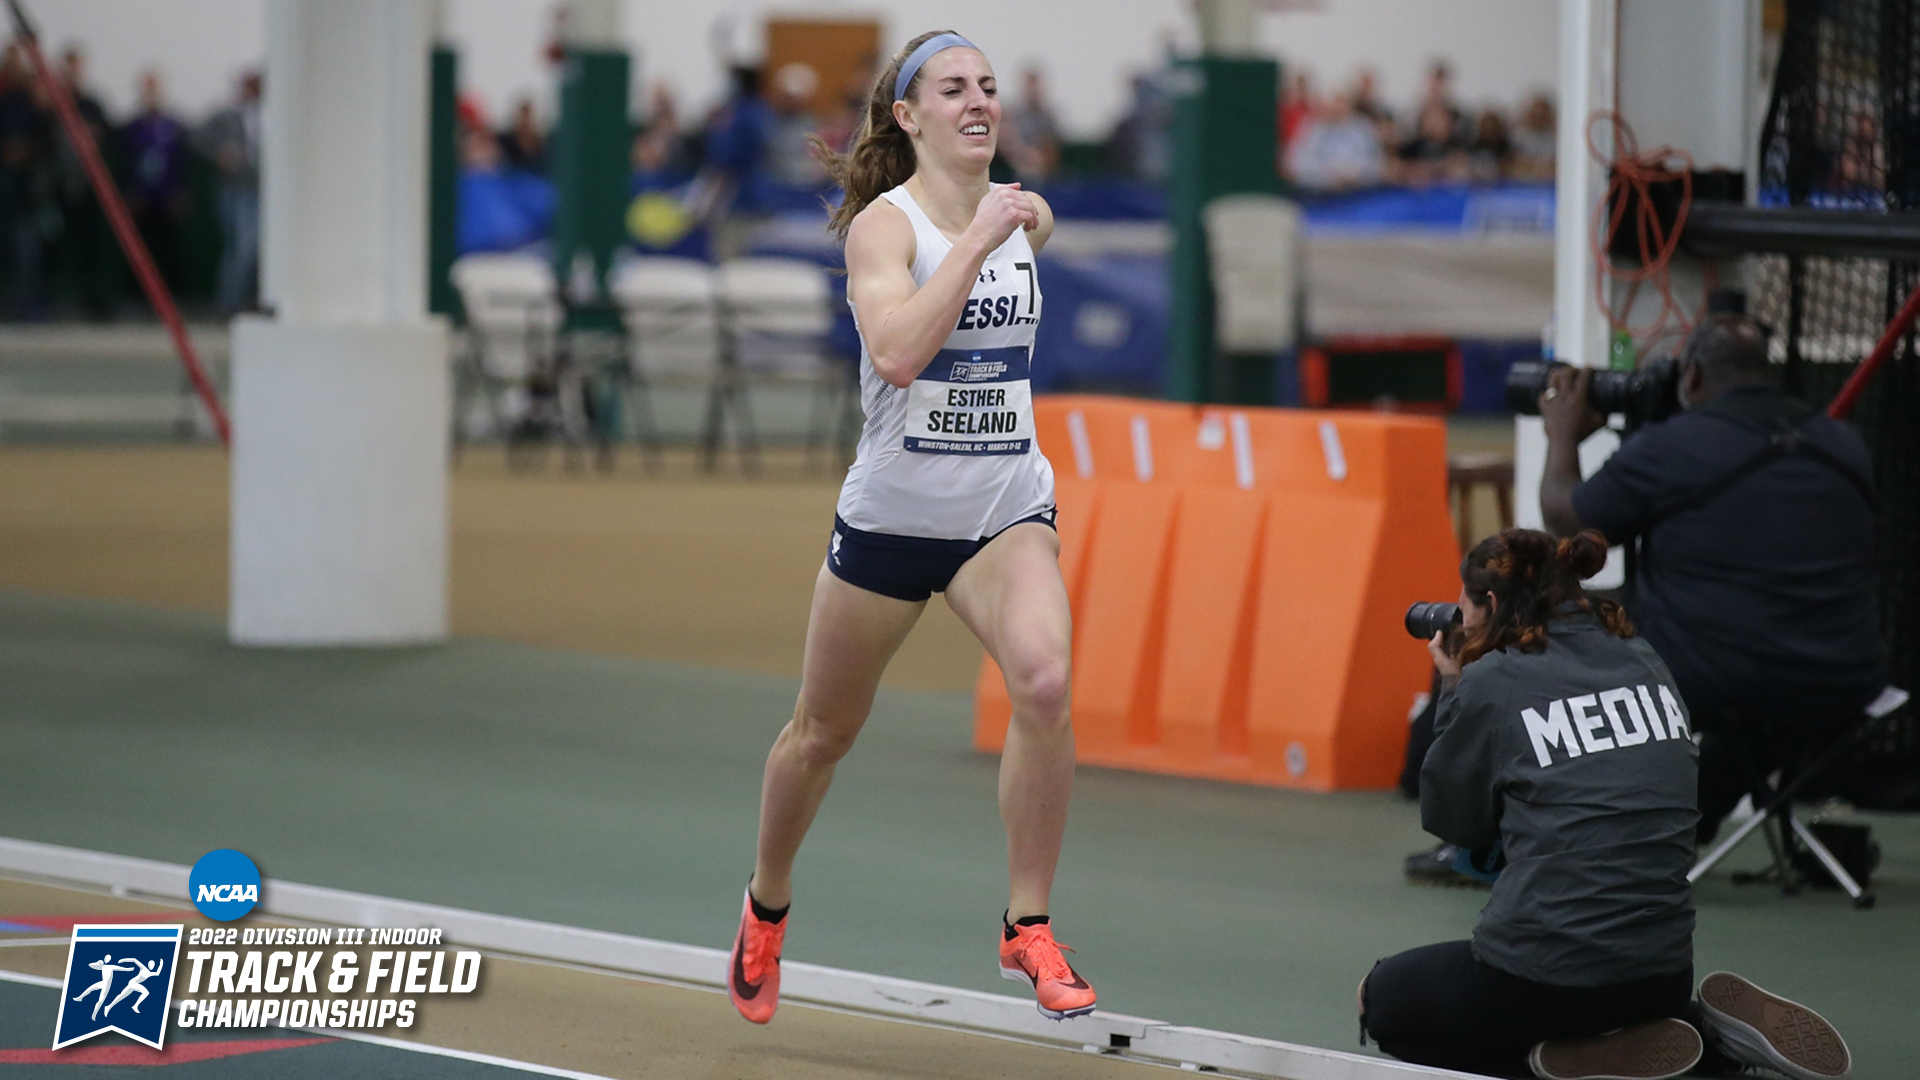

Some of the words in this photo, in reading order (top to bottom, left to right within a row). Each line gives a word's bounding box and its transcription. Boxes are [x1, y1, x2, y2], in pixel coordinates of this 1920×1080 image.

[1014, 262, 1034, 314] 7
[956, 295, 1038, 330] ESSI
[947, 389, 1005, 407] ESTHER
[927, 410, 1017, 434] SEELAND
[918, 440, 972, 452] WINSTON-SALEM,
[973, 443, 983, 451] NC
[987, 442, 1008, 451] MARCH
[1520, 684, 1692, 768] MEDIA
